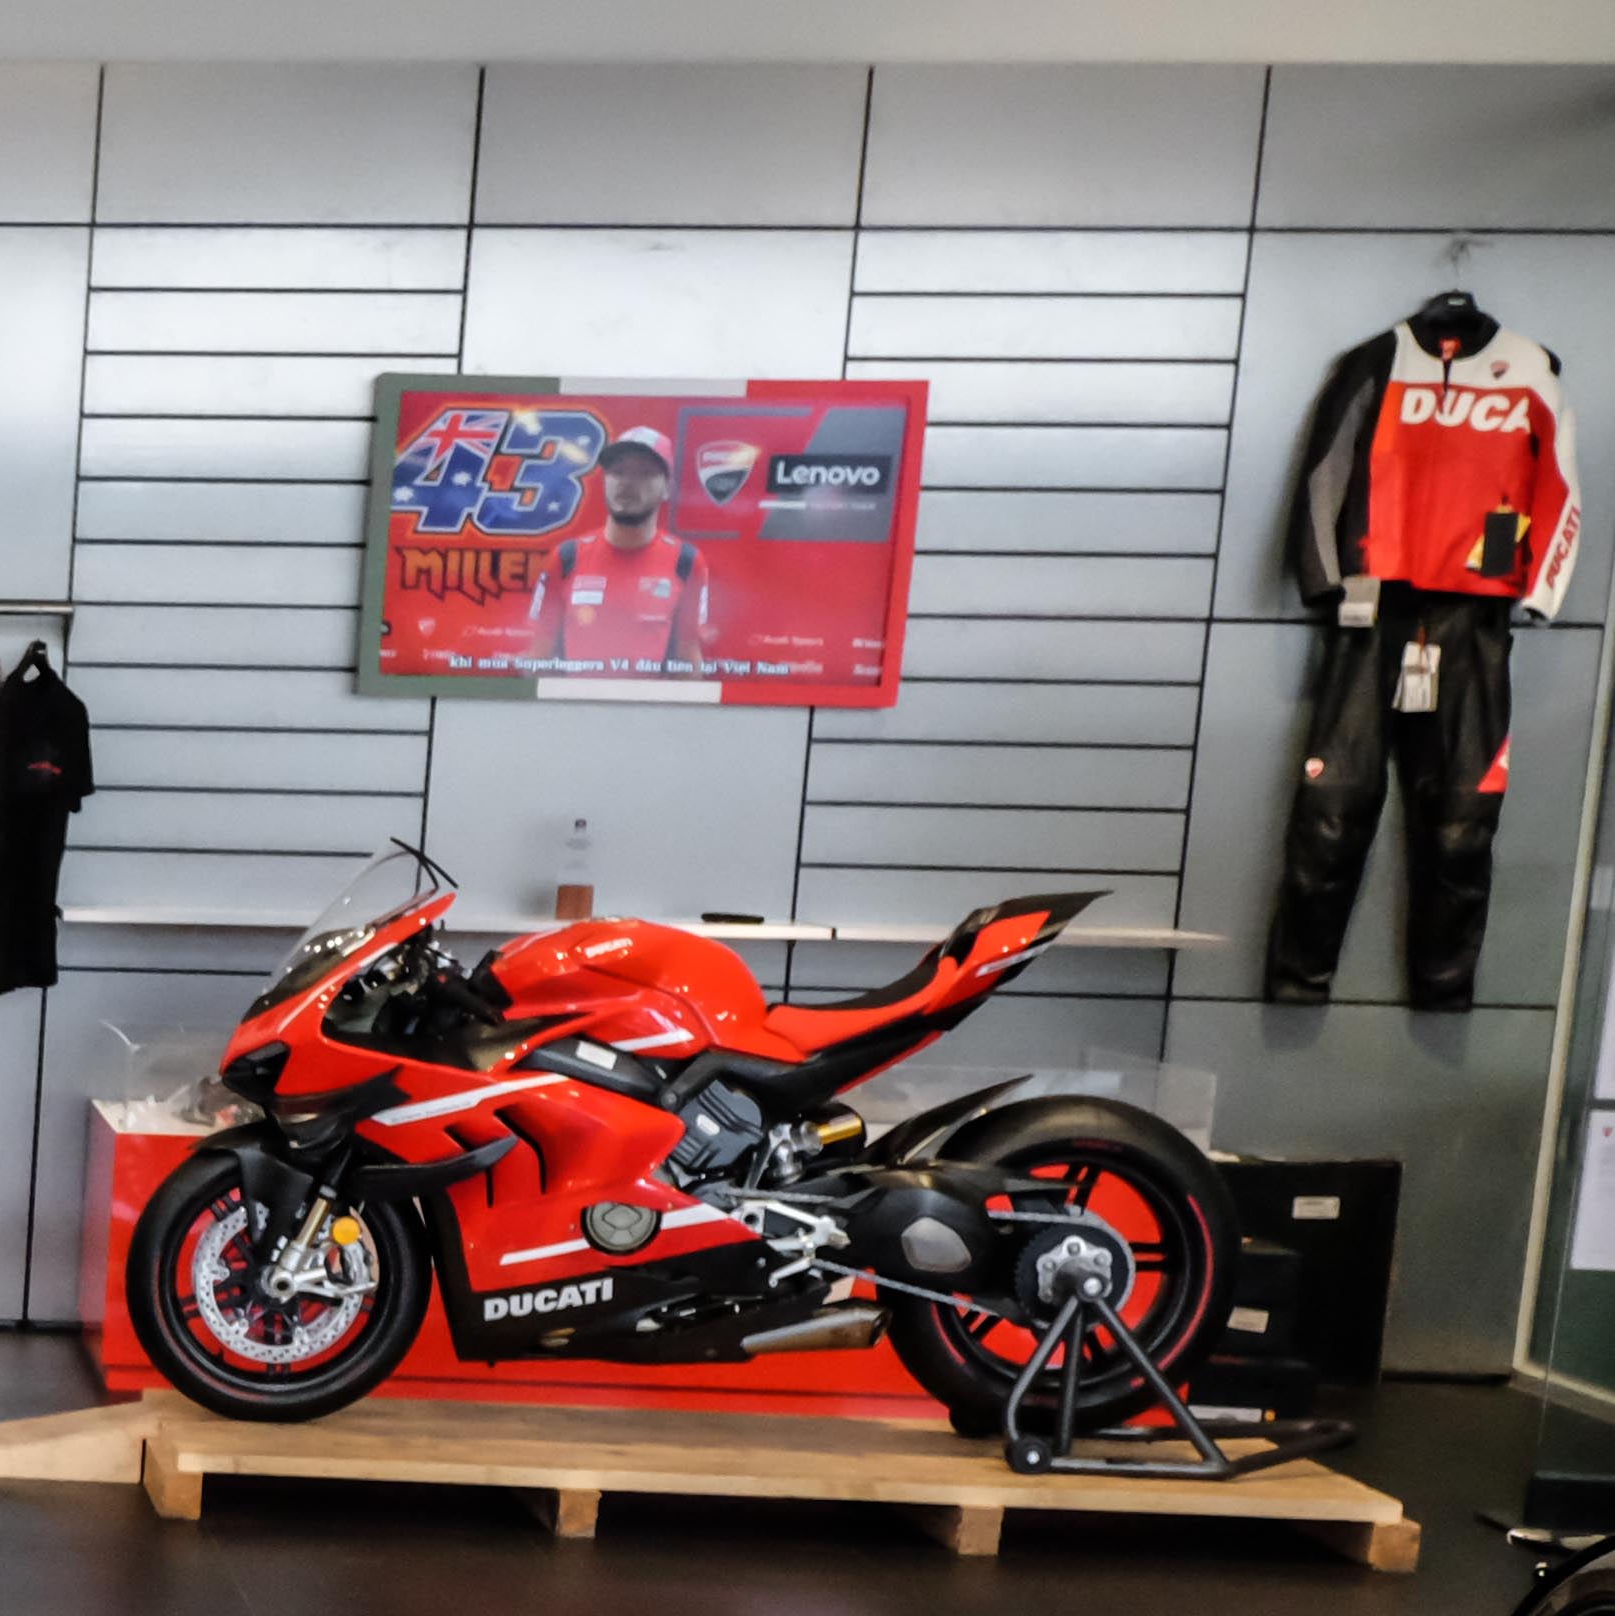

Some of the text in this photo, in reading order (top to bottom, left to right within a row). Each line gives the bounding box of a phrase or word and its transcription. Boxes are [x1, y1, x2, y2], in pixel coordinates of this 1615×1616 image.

[391, 409, 606, 535] 43
[776, 460, 881, 486] Lenovo
[1546, 505, 1581, 589] DUCATI
[484, 1277, 614, 1322] DUCATI
